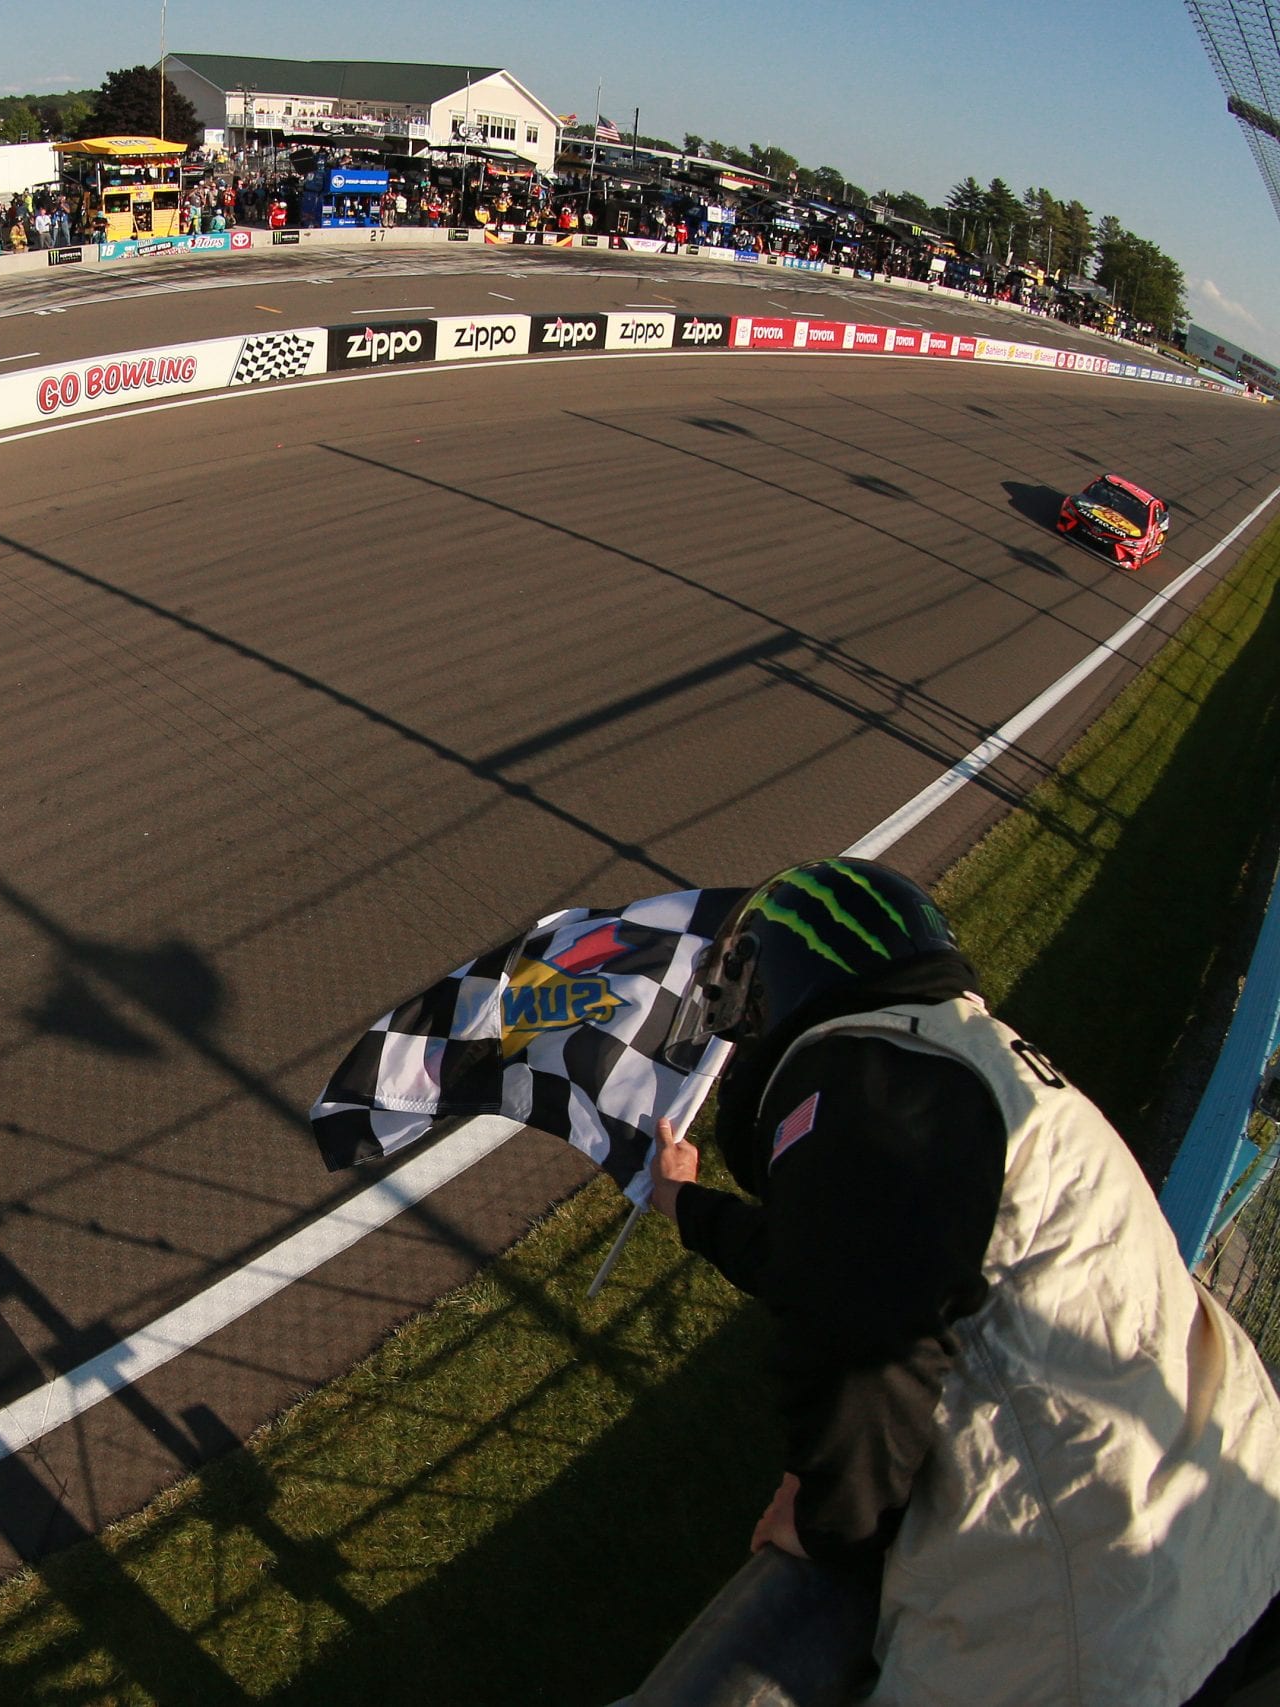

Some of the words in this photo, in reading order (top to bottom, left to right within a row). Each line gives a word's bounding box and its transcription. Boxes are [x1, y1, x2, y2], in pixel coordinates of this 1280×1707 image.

[370, 229, 386, 242] 27
[100, 244, 115, 257] 18
[753, 325, 784, 340] TOYOTA
[808, 329, 835, 342] TOYOTA
[855, 332, 878, 345] TOYOTA
[895, 335, 915, 348] TOYOTA
[928, 338, 947, 350] TOYOTA
[37, 372, 80, 415] GO
[85, 355, 198, 400] BOWLING
